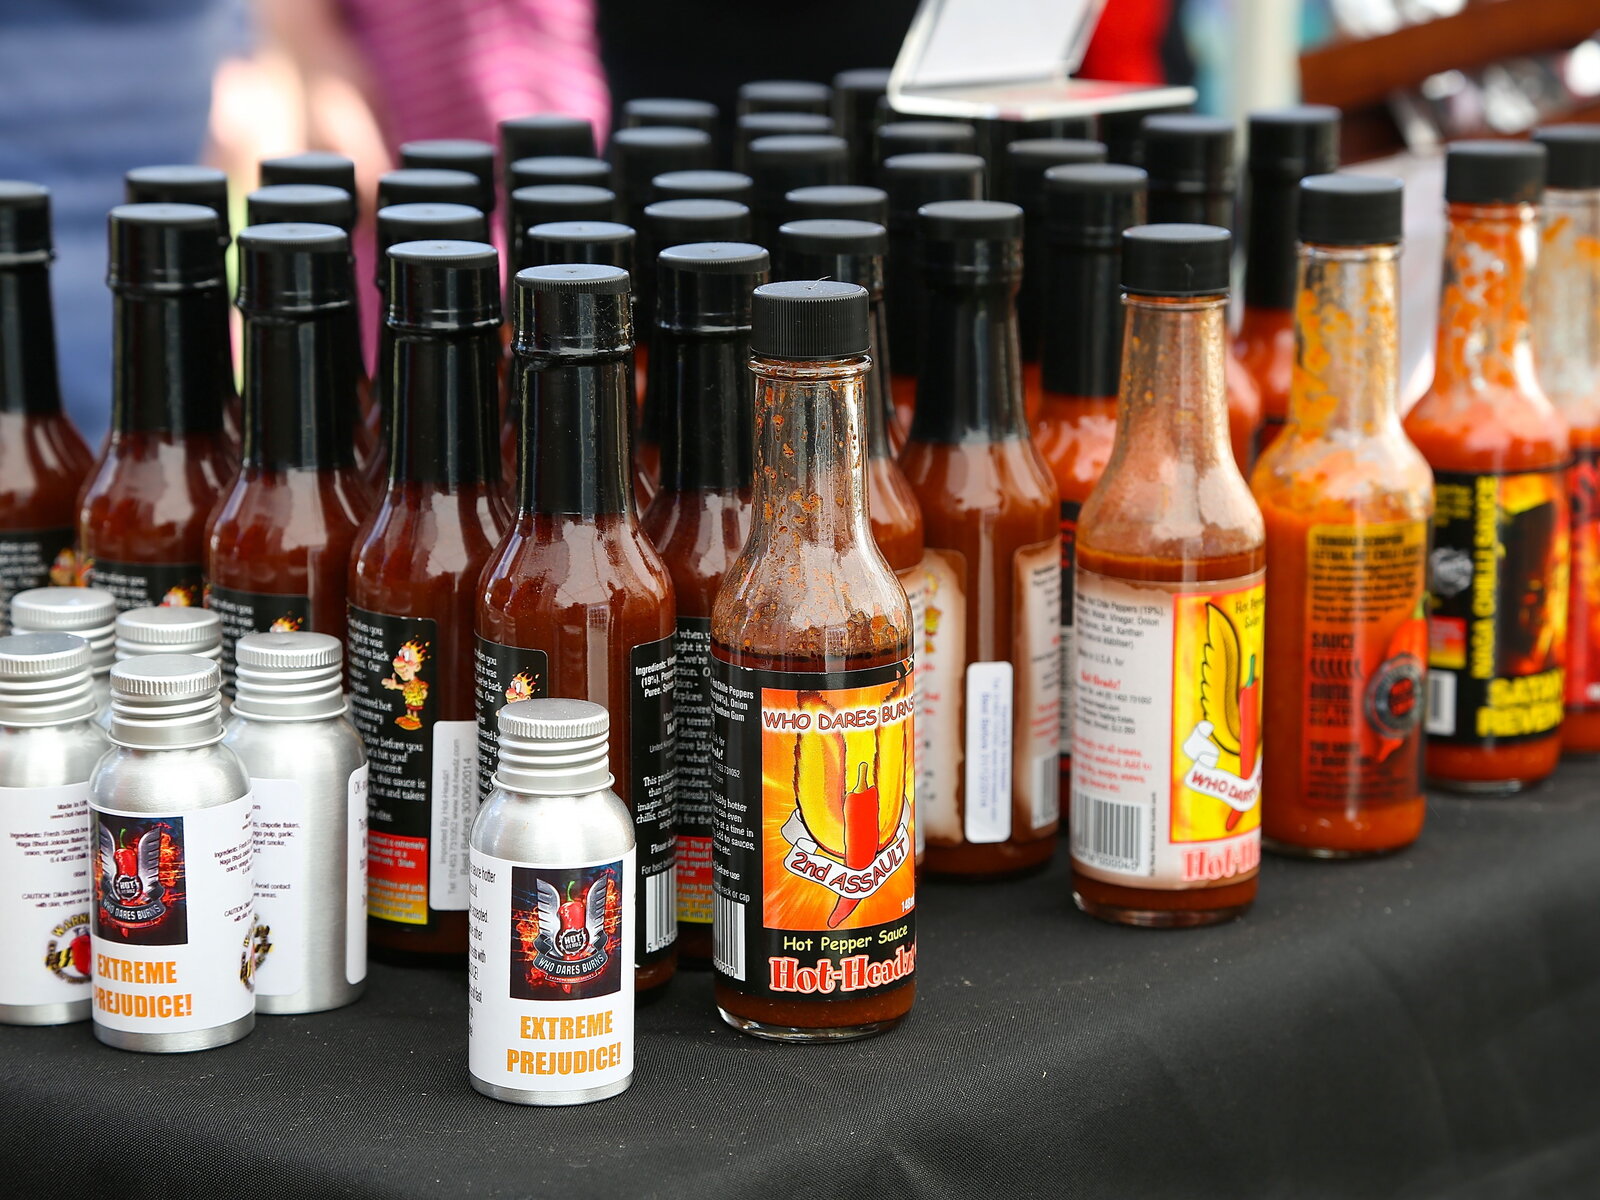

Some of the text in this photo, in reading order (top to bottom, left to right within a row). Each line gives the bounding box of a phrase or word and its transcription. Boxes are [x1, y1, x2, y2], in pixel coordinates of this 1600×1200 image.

[729, 685, 754, 700] Peppers
[730, 698, 748, 711] Onion
[731, 710, 745, 722] Gum
[763, 711, 811, 730] WHO
[818, 709, 878, 730] DARES
[1191, 770, 1228, 794] WHO
[727, 798, 748, 812] hotter
[727, 811, 742, 823] even
[730, 824, 745, 838] time
[746, 827, 754, 838] in
[731, 837, 756, 851] sauces,
[729, 871, 740, 881] use
[791, 838, 906, 894] 2nd ASSAULT
[739, 893, 751, 903] cap
[103, 898, 161, 920] WHO DARES BURNS
[51, 912, 90, 937] WARN
[783, 924, 908, 954] Hot Pepper Sauce
[97, 953, 177, 984] EXTREME
[538, 953, 605, 975] WHO DARES BURNS
[520, 1010, 613, 1040] EXTREME
[507, 1042, 621, 1075] PREJUDICE!
